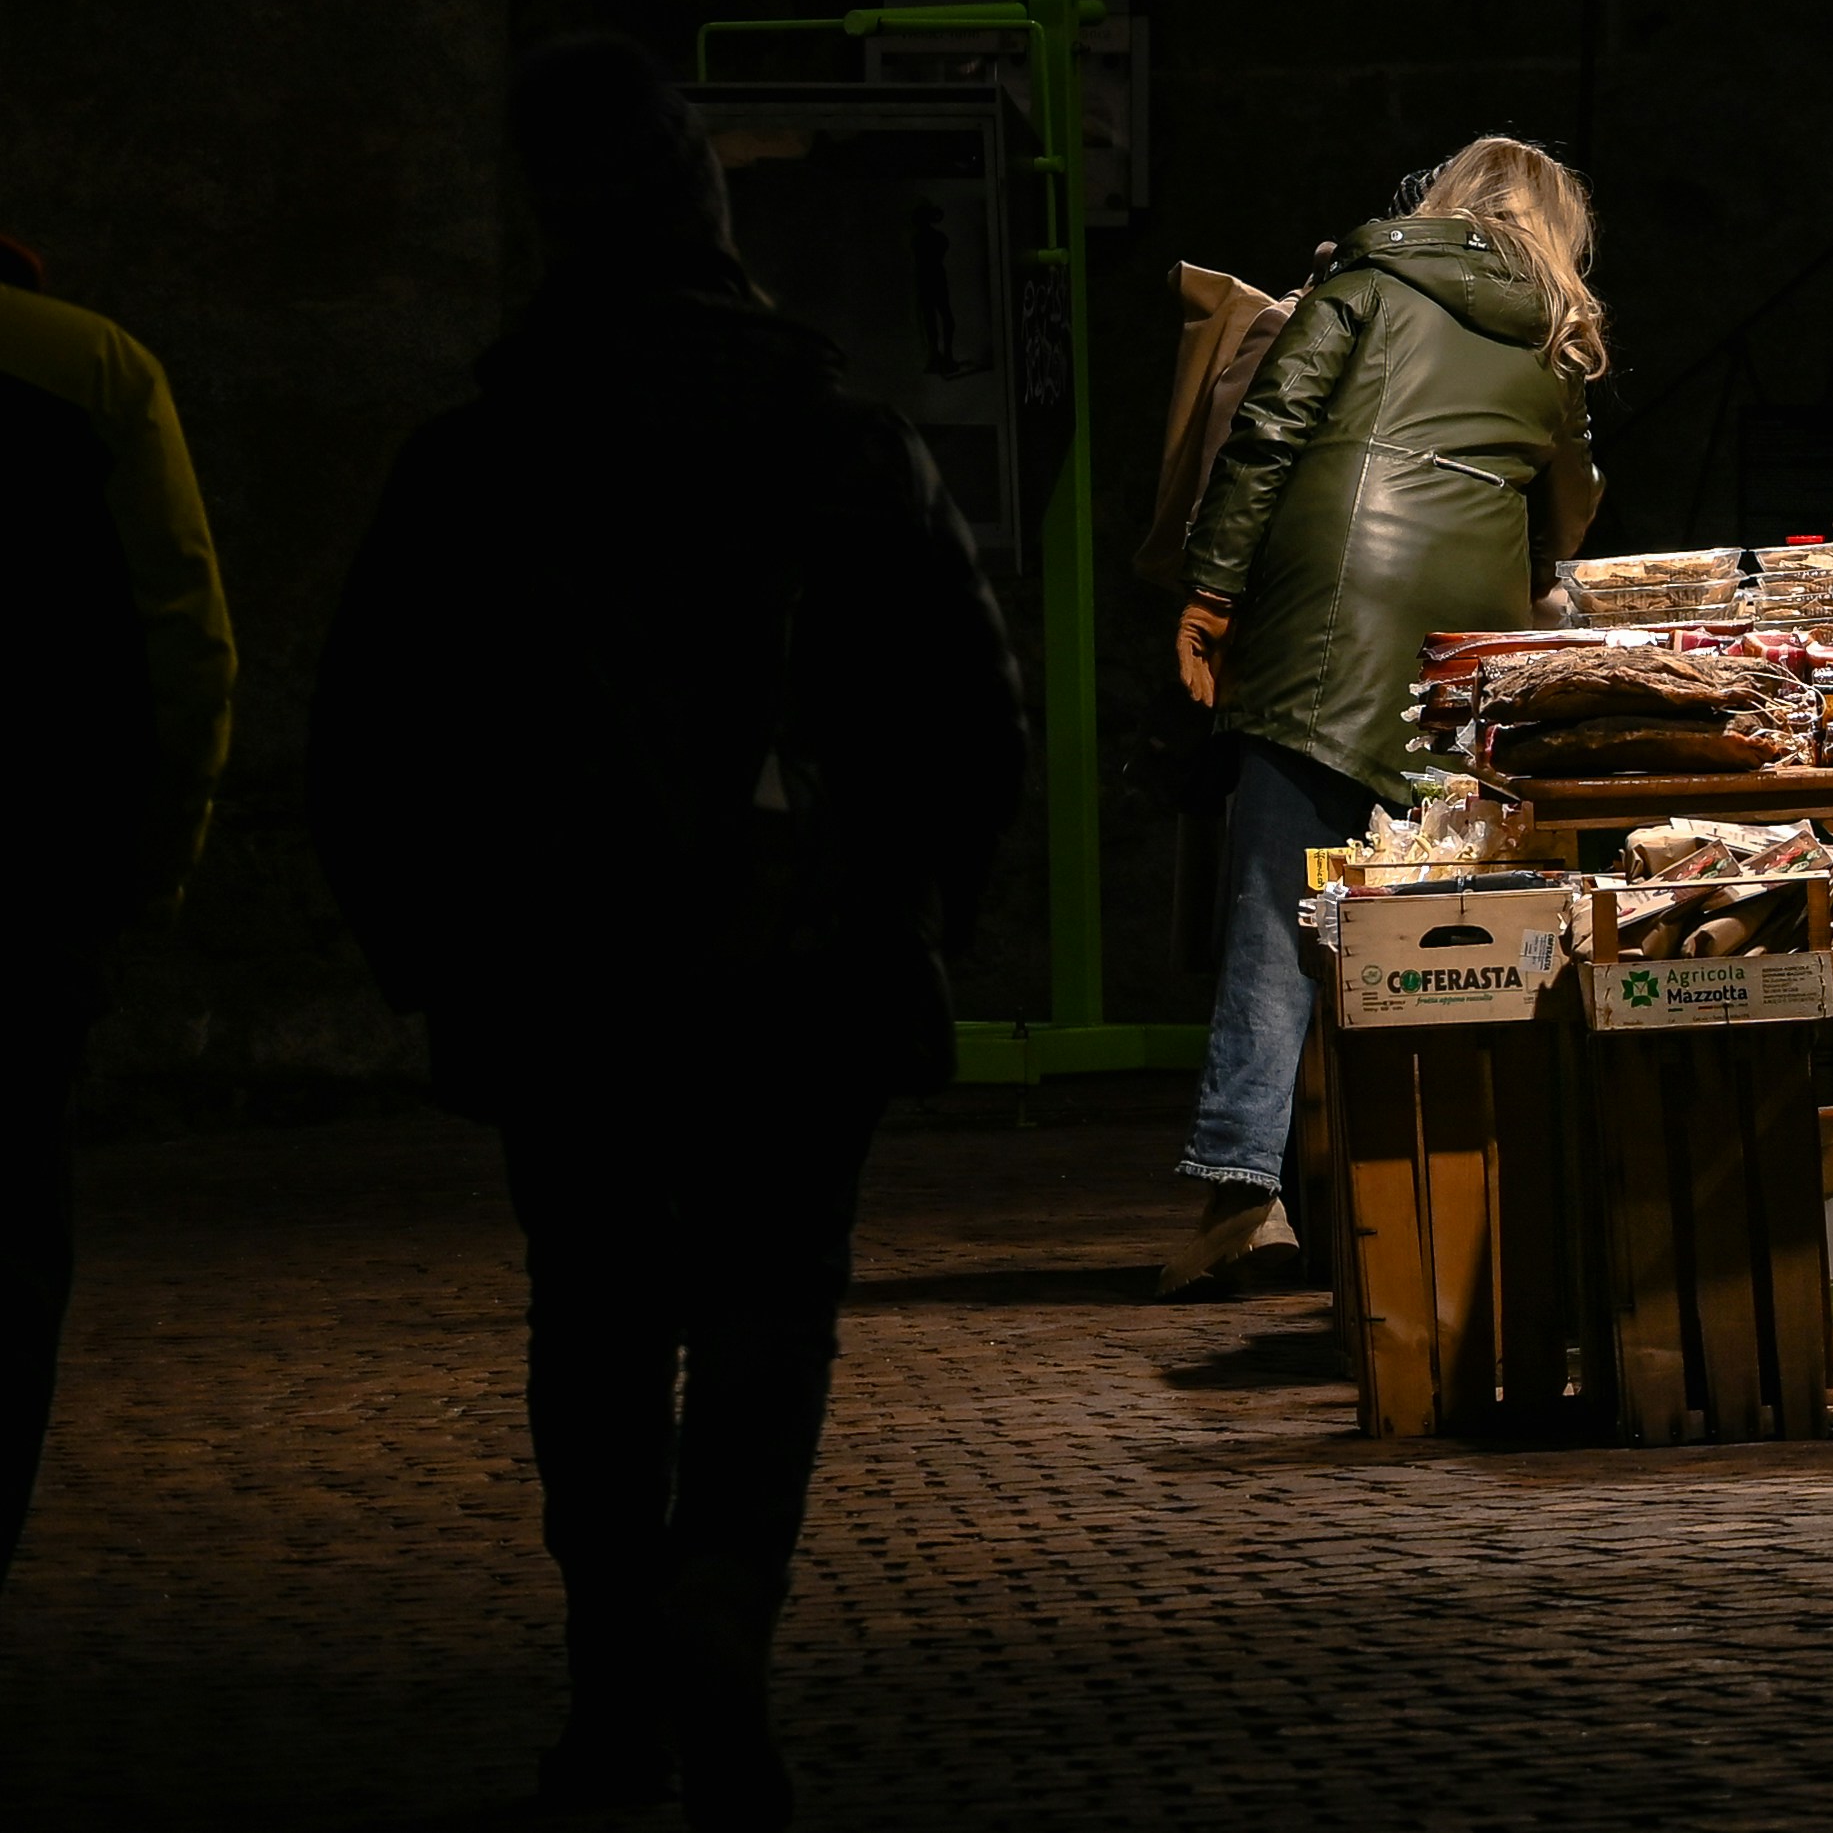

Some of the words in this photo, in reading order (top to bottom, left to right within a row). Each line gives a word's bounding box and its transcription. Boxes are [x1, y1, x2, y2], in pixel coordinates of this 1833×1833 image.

[1387, 966, 1523, 994] COFERASTA
[1667, 965, 1746, 988] Agricola
[1667, 985, 1748, 1004] Mazzotta
